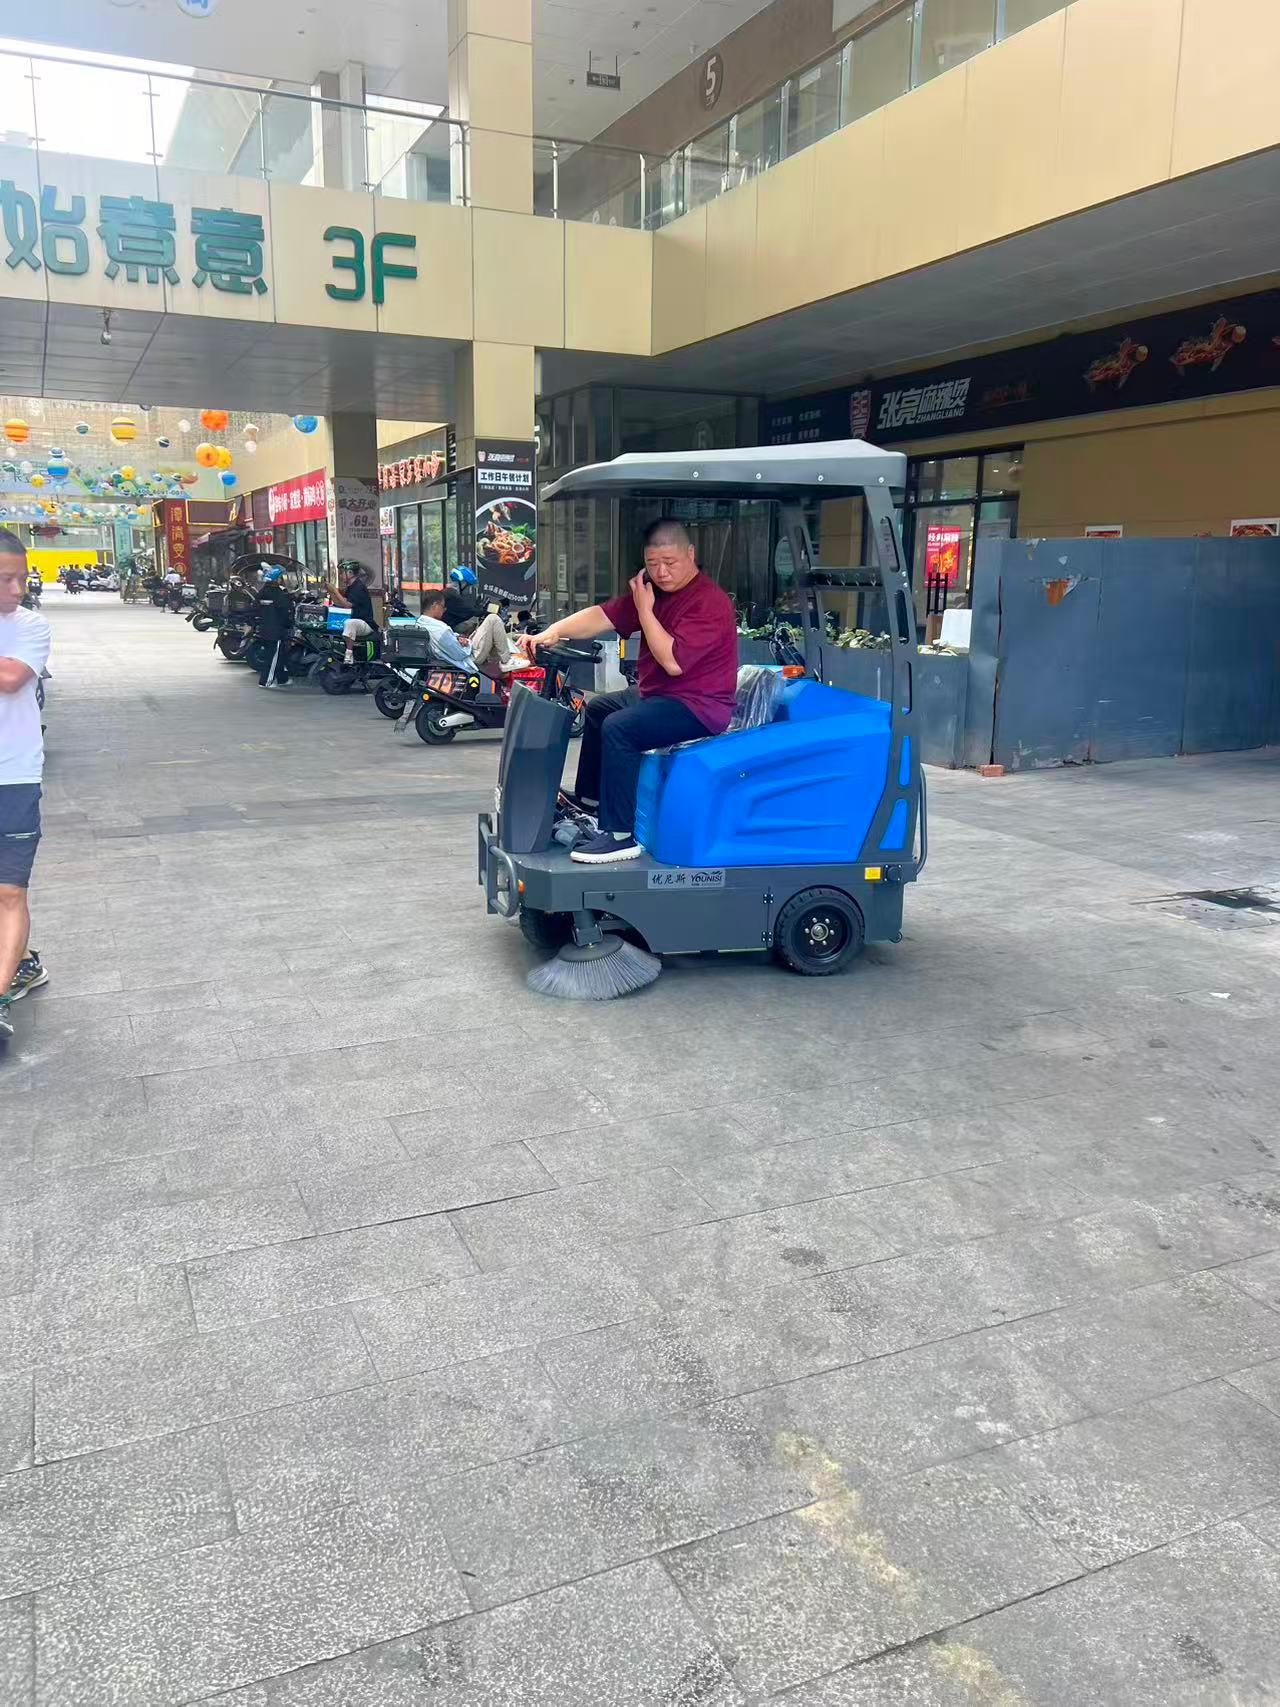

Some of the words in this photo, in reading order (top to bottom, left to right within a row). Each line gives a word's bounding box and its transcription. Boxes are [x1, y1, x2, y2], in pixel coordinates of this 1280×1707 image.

[706, 56, 717, 96] 5
[0, 180, 268, 295] 始煮意
[323, 226, 417, 305] 3F
[916, 407, 965, 424] ZHANGLIANG
[354, 515, 368, 527] 69
[652, 873, 686, 885] 优尼斯
